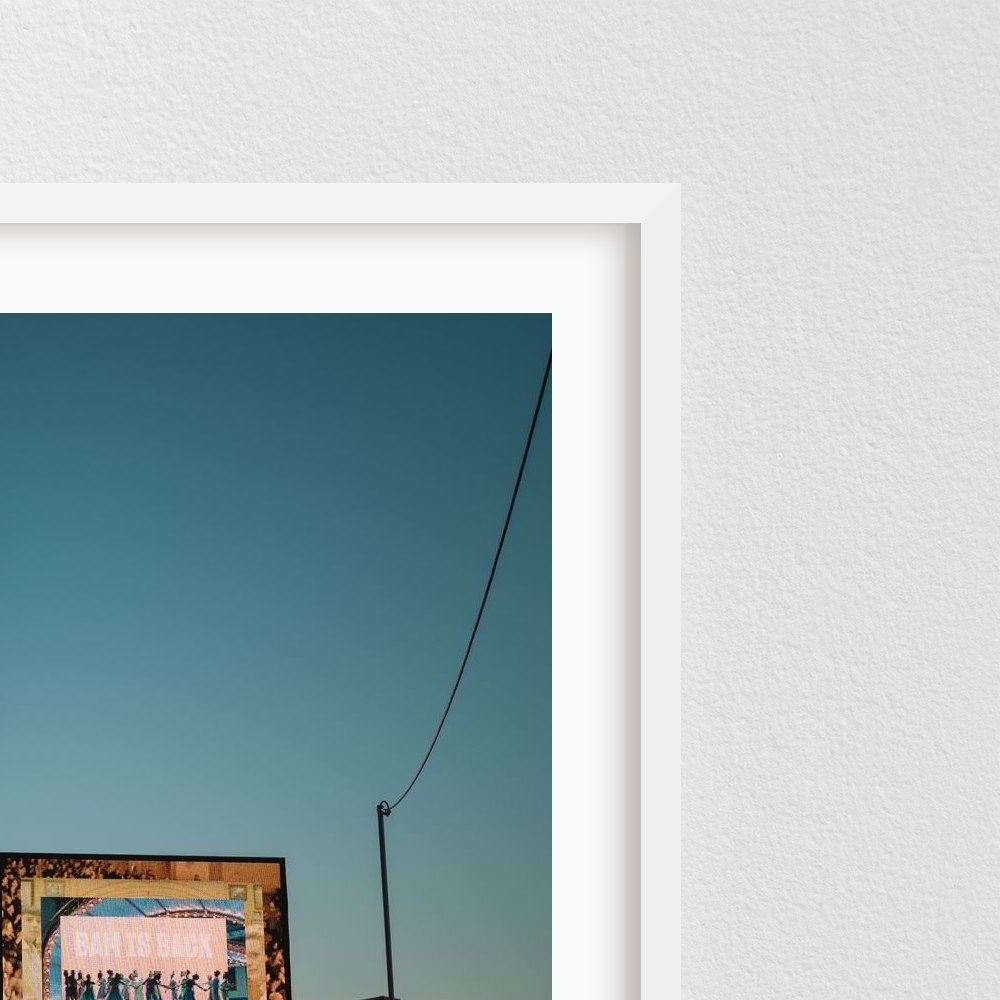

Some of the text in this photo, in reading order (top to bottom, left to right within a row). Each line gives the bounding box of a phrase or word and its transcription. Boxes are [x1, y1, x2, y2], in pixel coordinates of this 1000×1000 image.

[75, 931, 213, 958] BAM IS BACK
